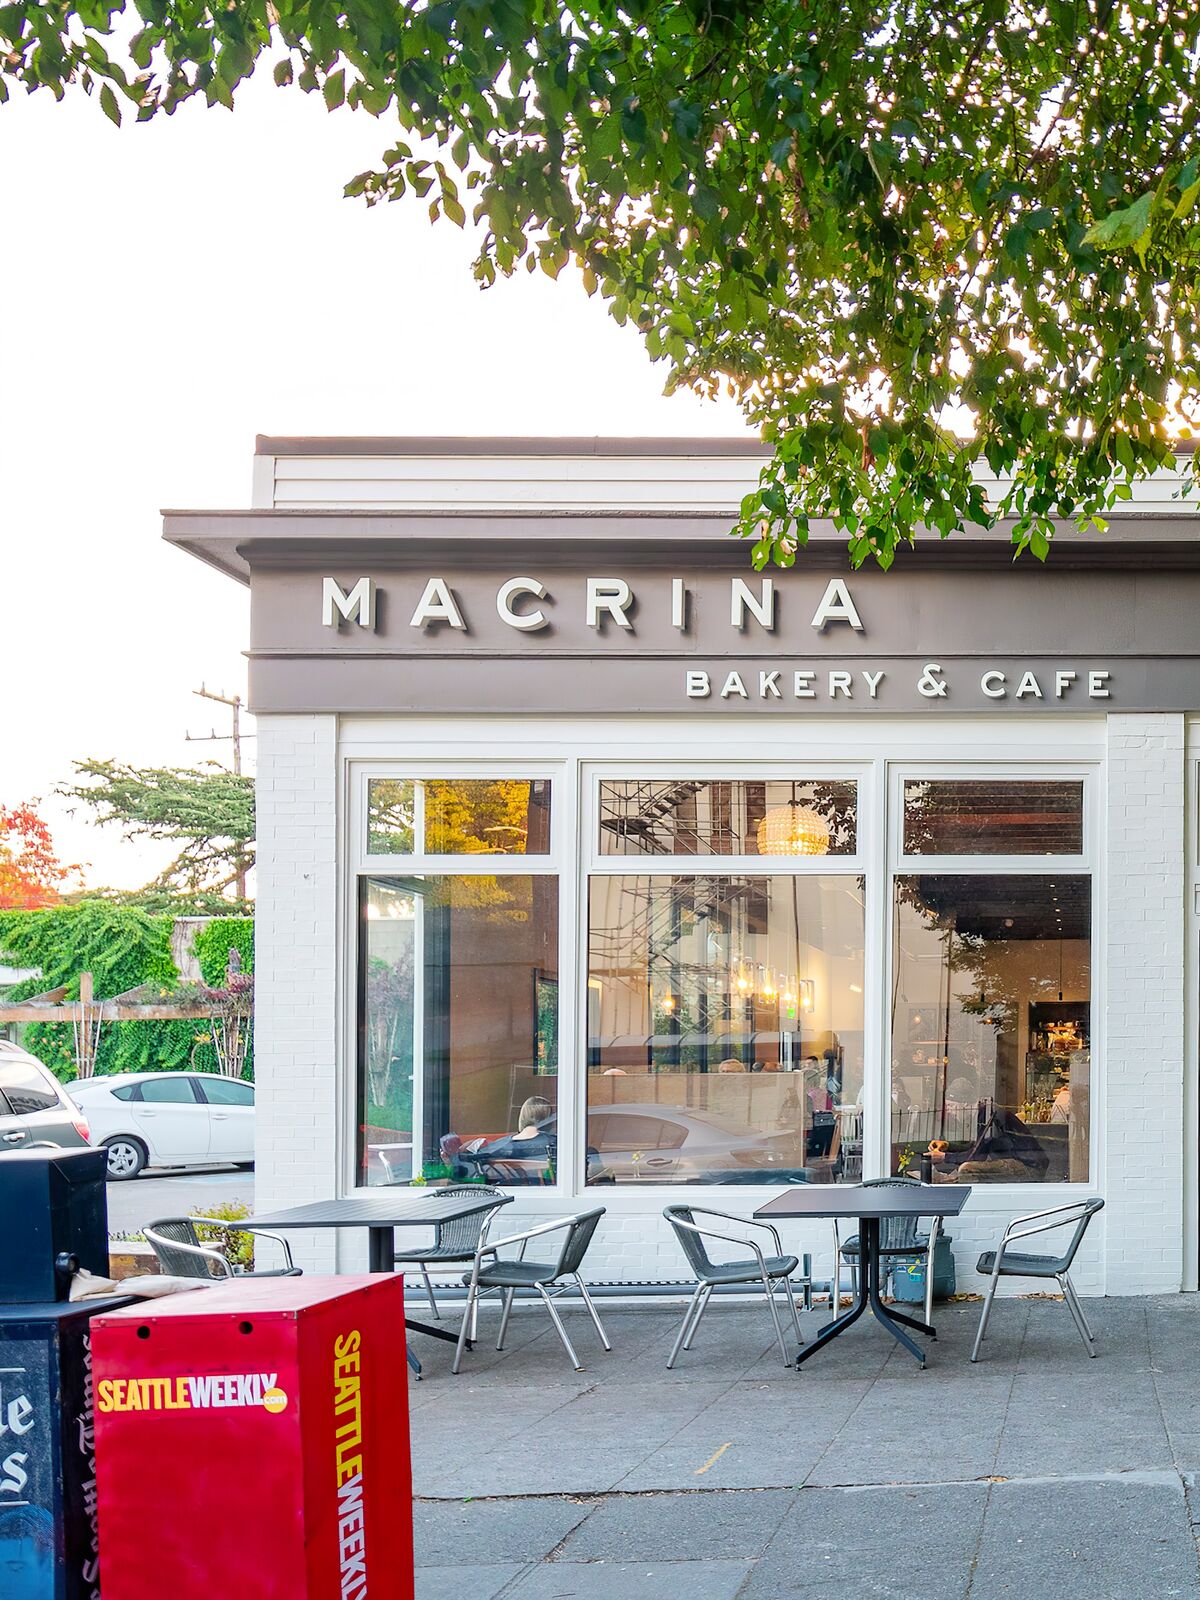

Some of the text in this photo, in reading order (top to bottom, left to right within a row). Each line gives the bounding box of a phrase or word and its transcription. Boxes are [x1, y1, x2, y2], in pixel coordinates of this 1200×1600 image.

[321, 576, 866, 631] MACRINA
[686, 663, 1110, 699] BAKERY & CAFE
